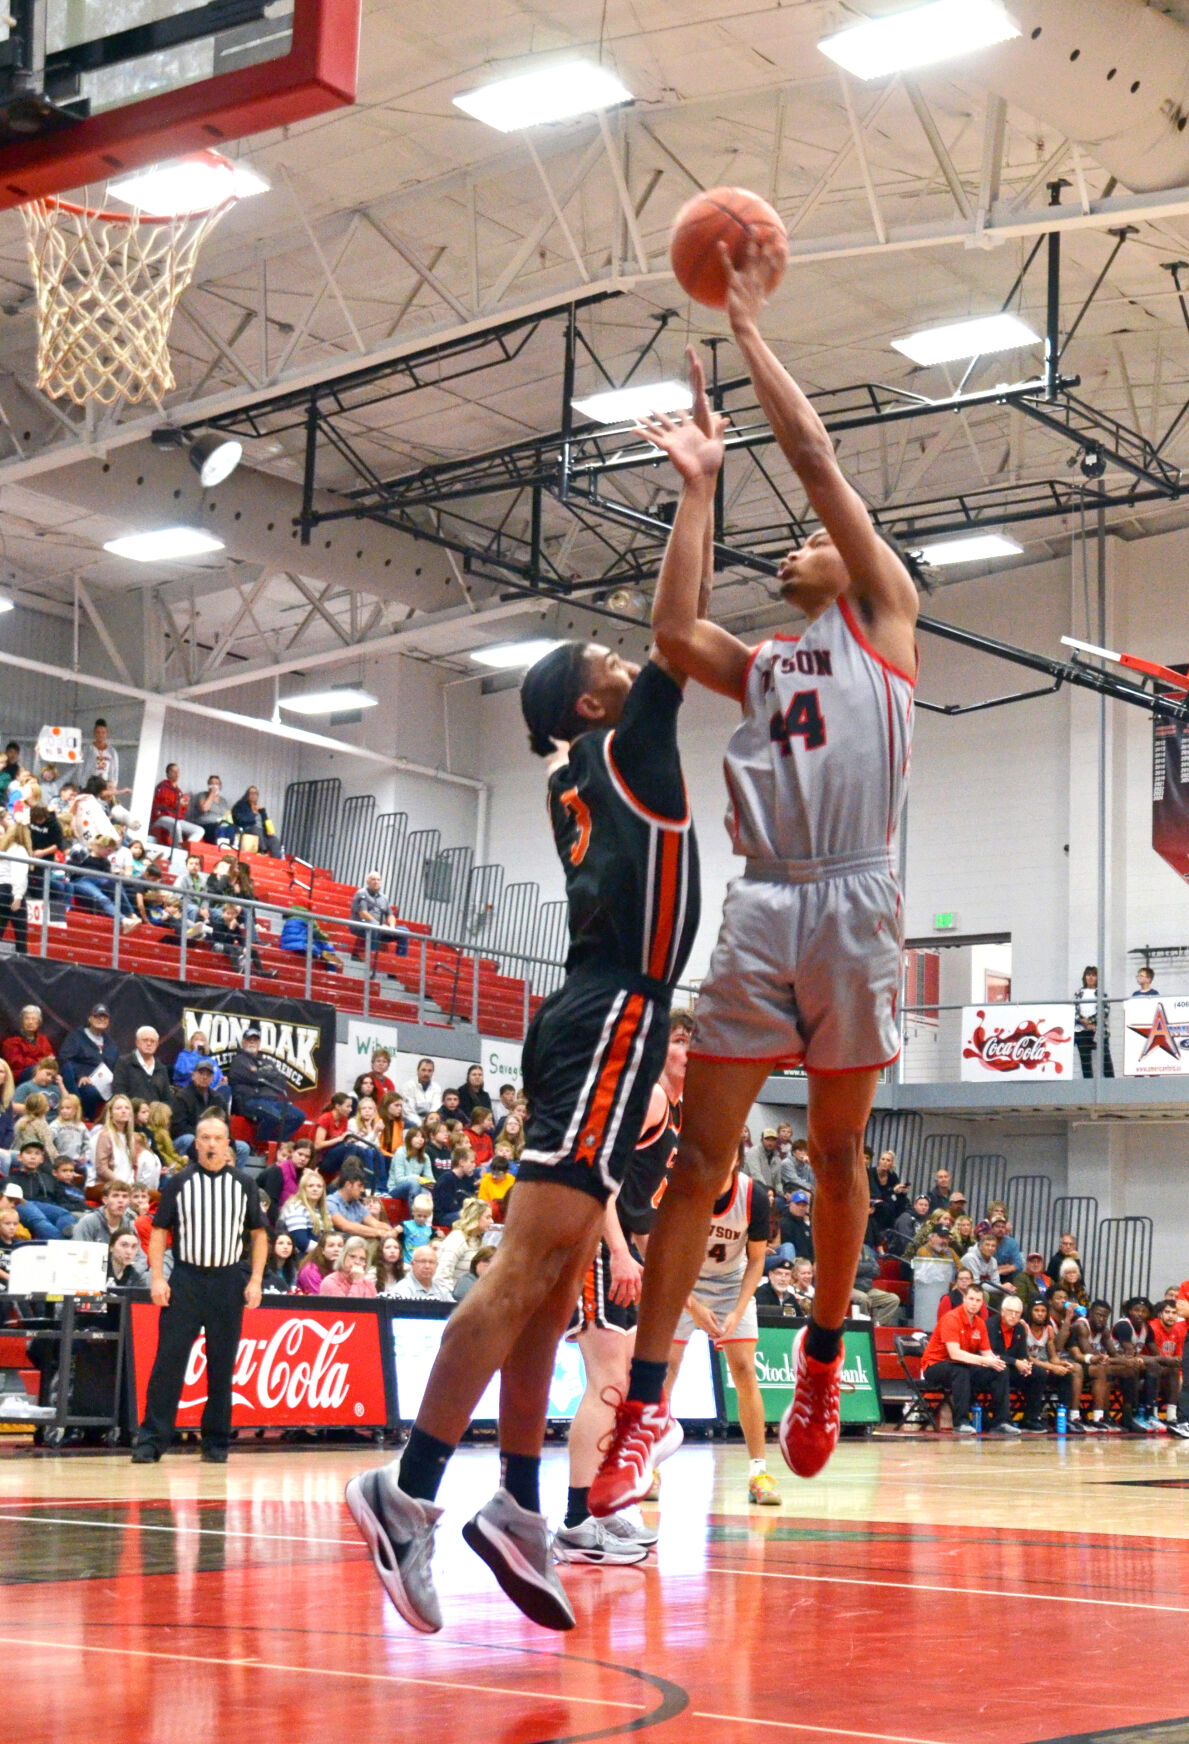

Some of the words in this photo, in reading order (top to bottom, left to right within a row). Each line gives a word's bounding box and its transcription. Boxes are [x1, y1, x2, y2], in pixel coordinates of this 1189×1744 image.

[258, 1020, 319, 1084] DAK
[983, 1035, 1047, 1061] Coca-Cola
[708, 1243, 727, 1263] 4
[178, 1318, 356, 1409] oa-Cola
